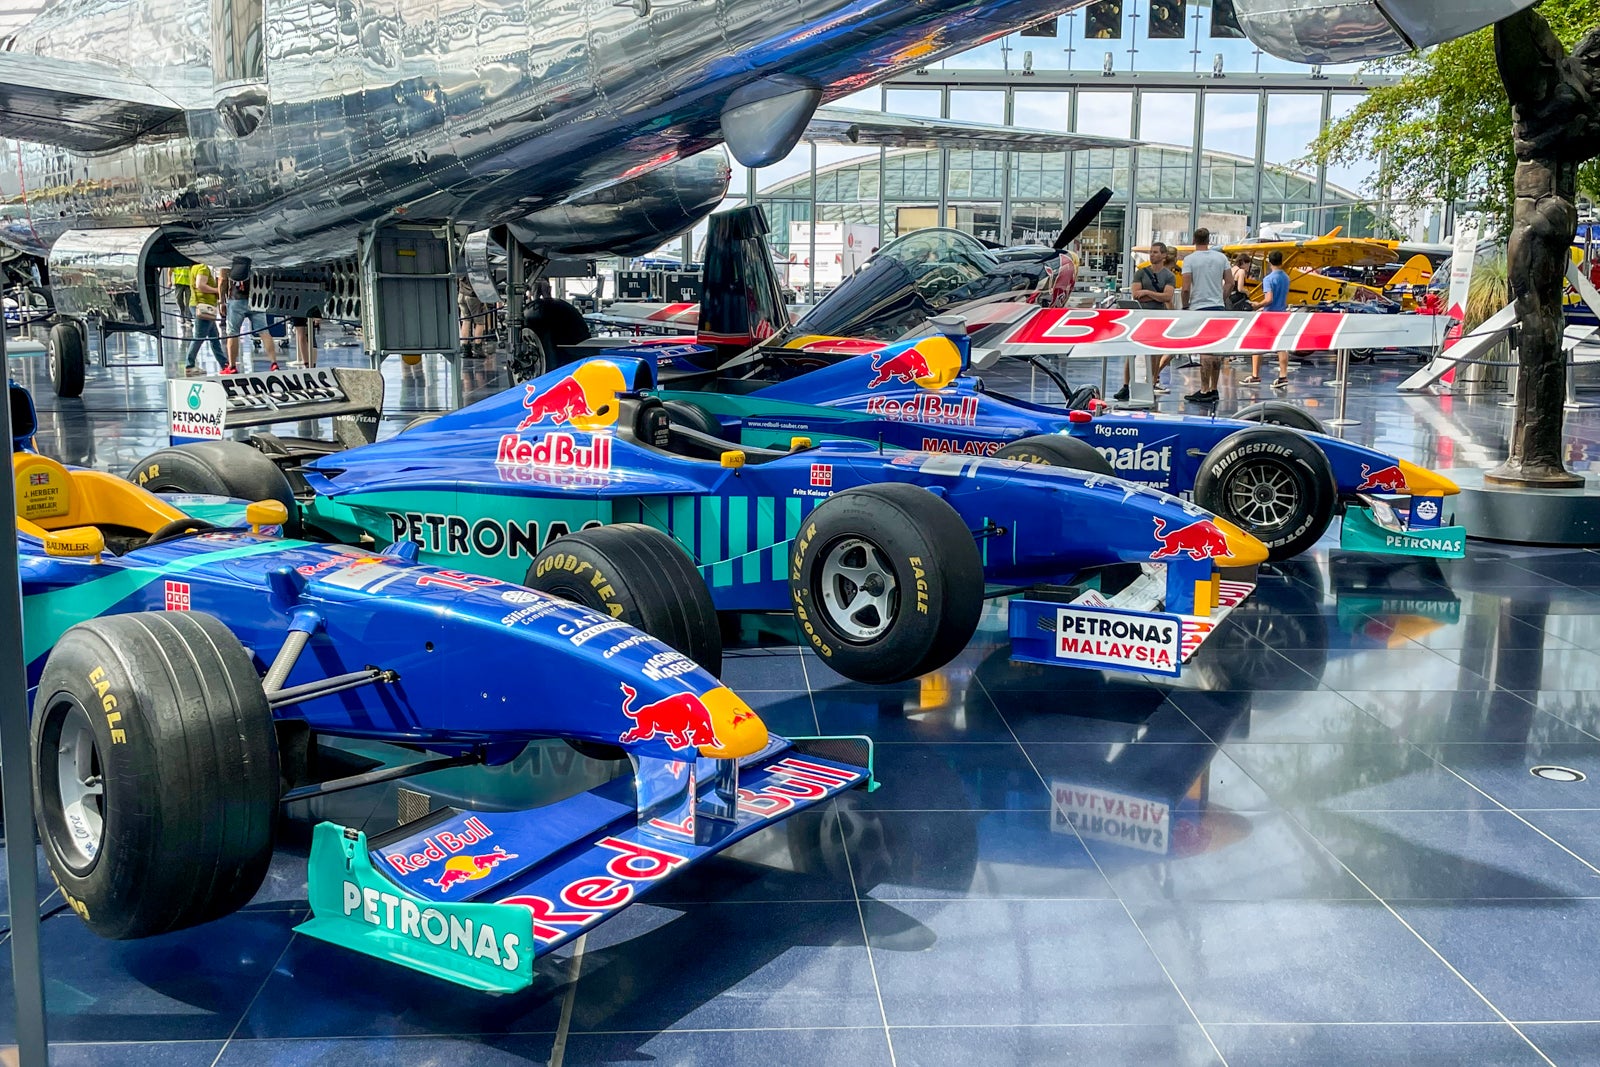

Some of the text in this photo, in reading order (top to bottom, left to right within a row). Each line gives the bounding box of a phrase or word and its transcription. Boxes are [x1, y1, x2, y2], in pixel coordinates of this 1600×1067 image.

[1001, 308, 1349, 352] Bull
[221, 371, 337, 407] ETRONAS
[866, 394, 979, 420] Red Bull
[172, 423, 222, 436] MALAYSIA
[748, 421, 808, 430] www.redbull-sauber.com
[1095, 424, 1138, 437] fkg.com
[495, 433, 553, 467] Red
[553, 433, 612, 473] Bull
[1211, 443, 1293, 479] BRIDGESTONE
[30, 488, 59, 497] HERBERT
[1263, 514, 1315, 549] POTEN
[1386, 535, 1461, 552] PETRONAS
[909, 556, 929, 615] EAGLE
[1062, 615, 1173, 645] PETRONAS
[1061, 637, 1172, 666] MALAYSIA
[89, 665, 127, 746] EAGLE
[737, 757, 861, 818] Bull
[386, 816, 494, 875] Red Bull
[497, 835, 690, 944] Red
[343, 880, 520, 972] PETRONAS
